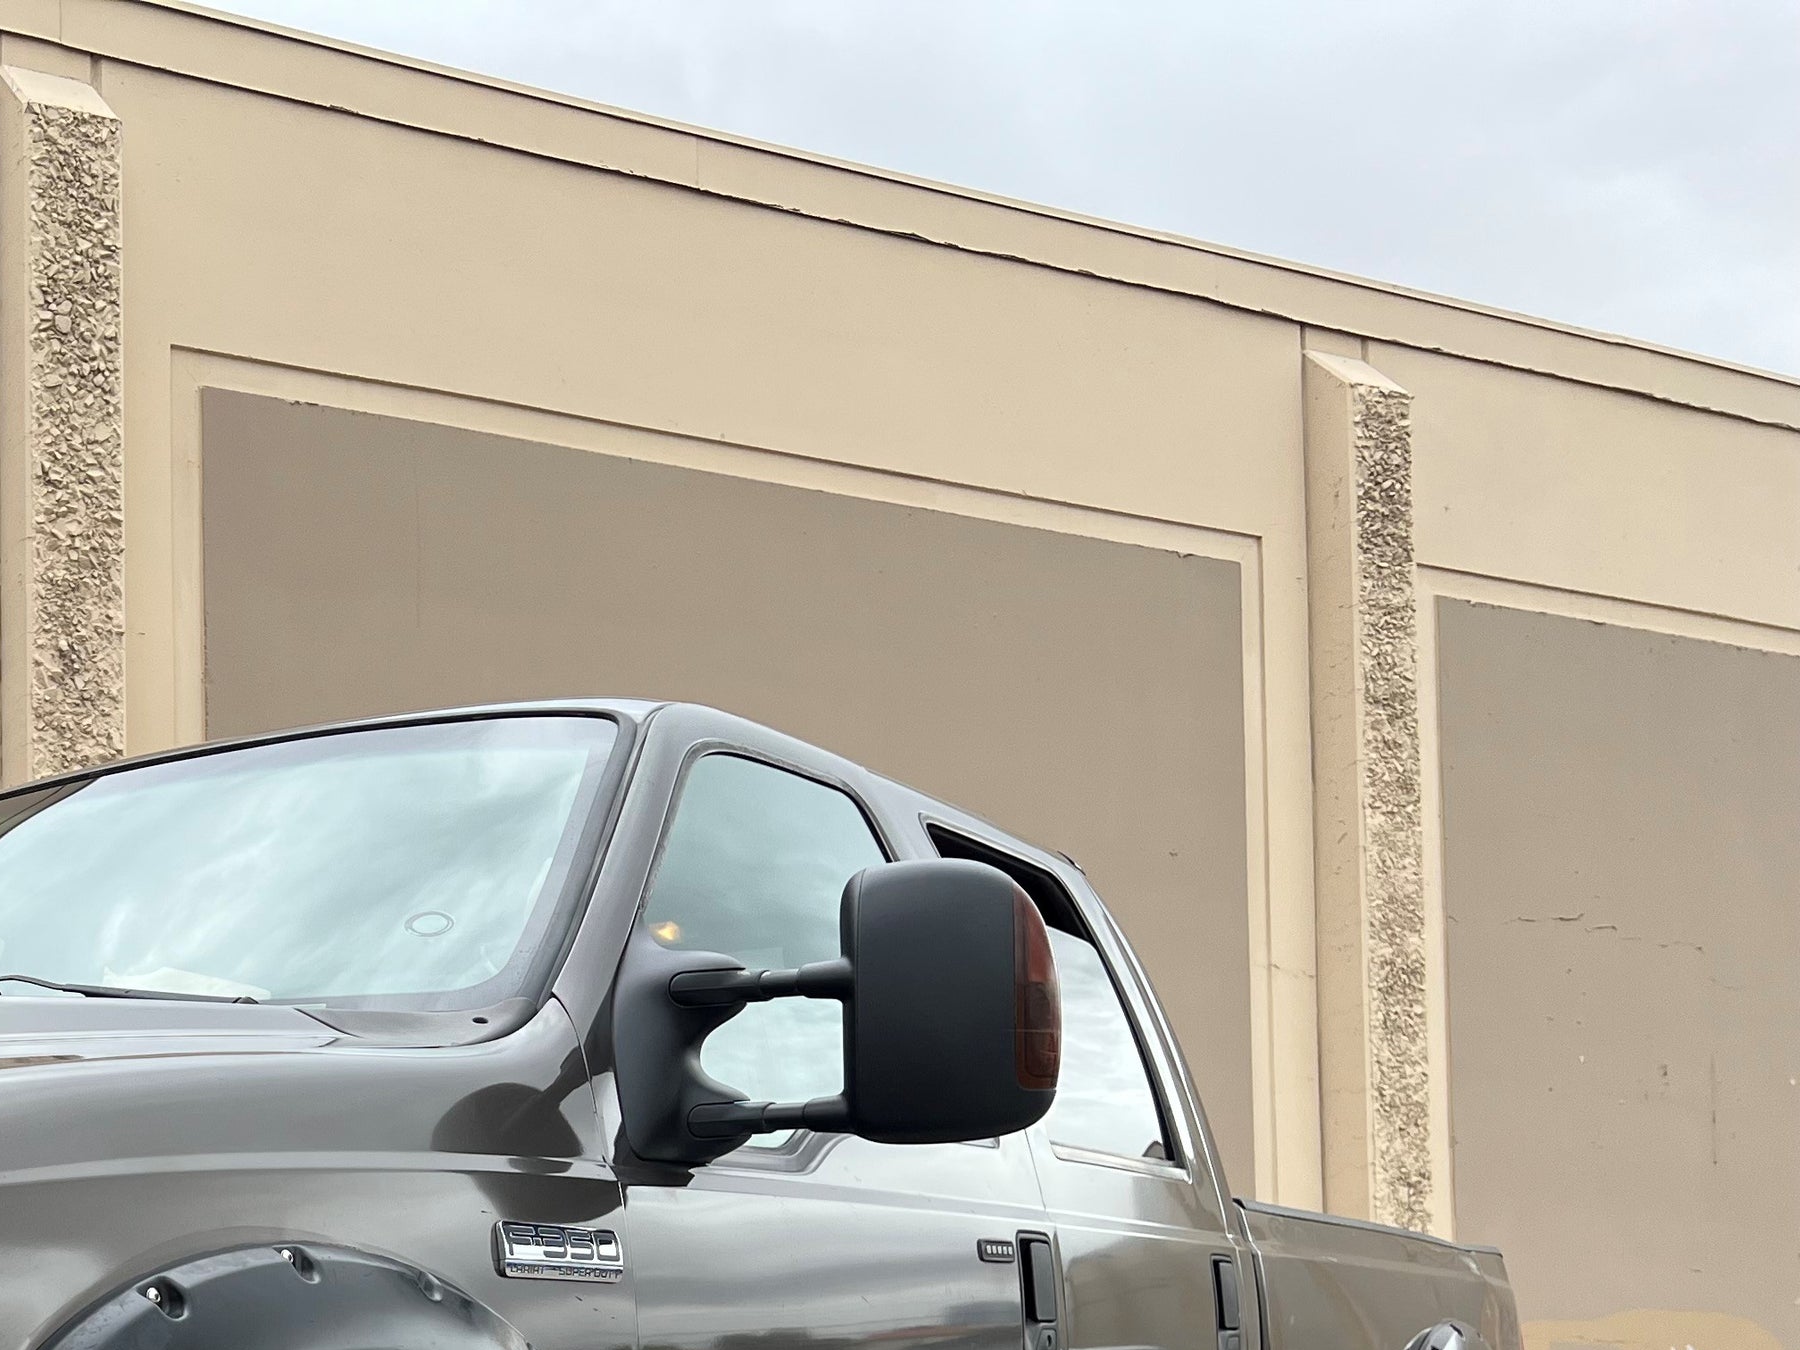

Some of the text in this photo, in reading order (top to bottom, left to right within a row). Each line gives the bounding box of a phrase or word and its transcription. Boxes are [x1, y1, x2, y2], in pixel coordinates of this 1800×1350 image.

[510, 1265, 619, 1279] LARIAT SUPER DUTY
